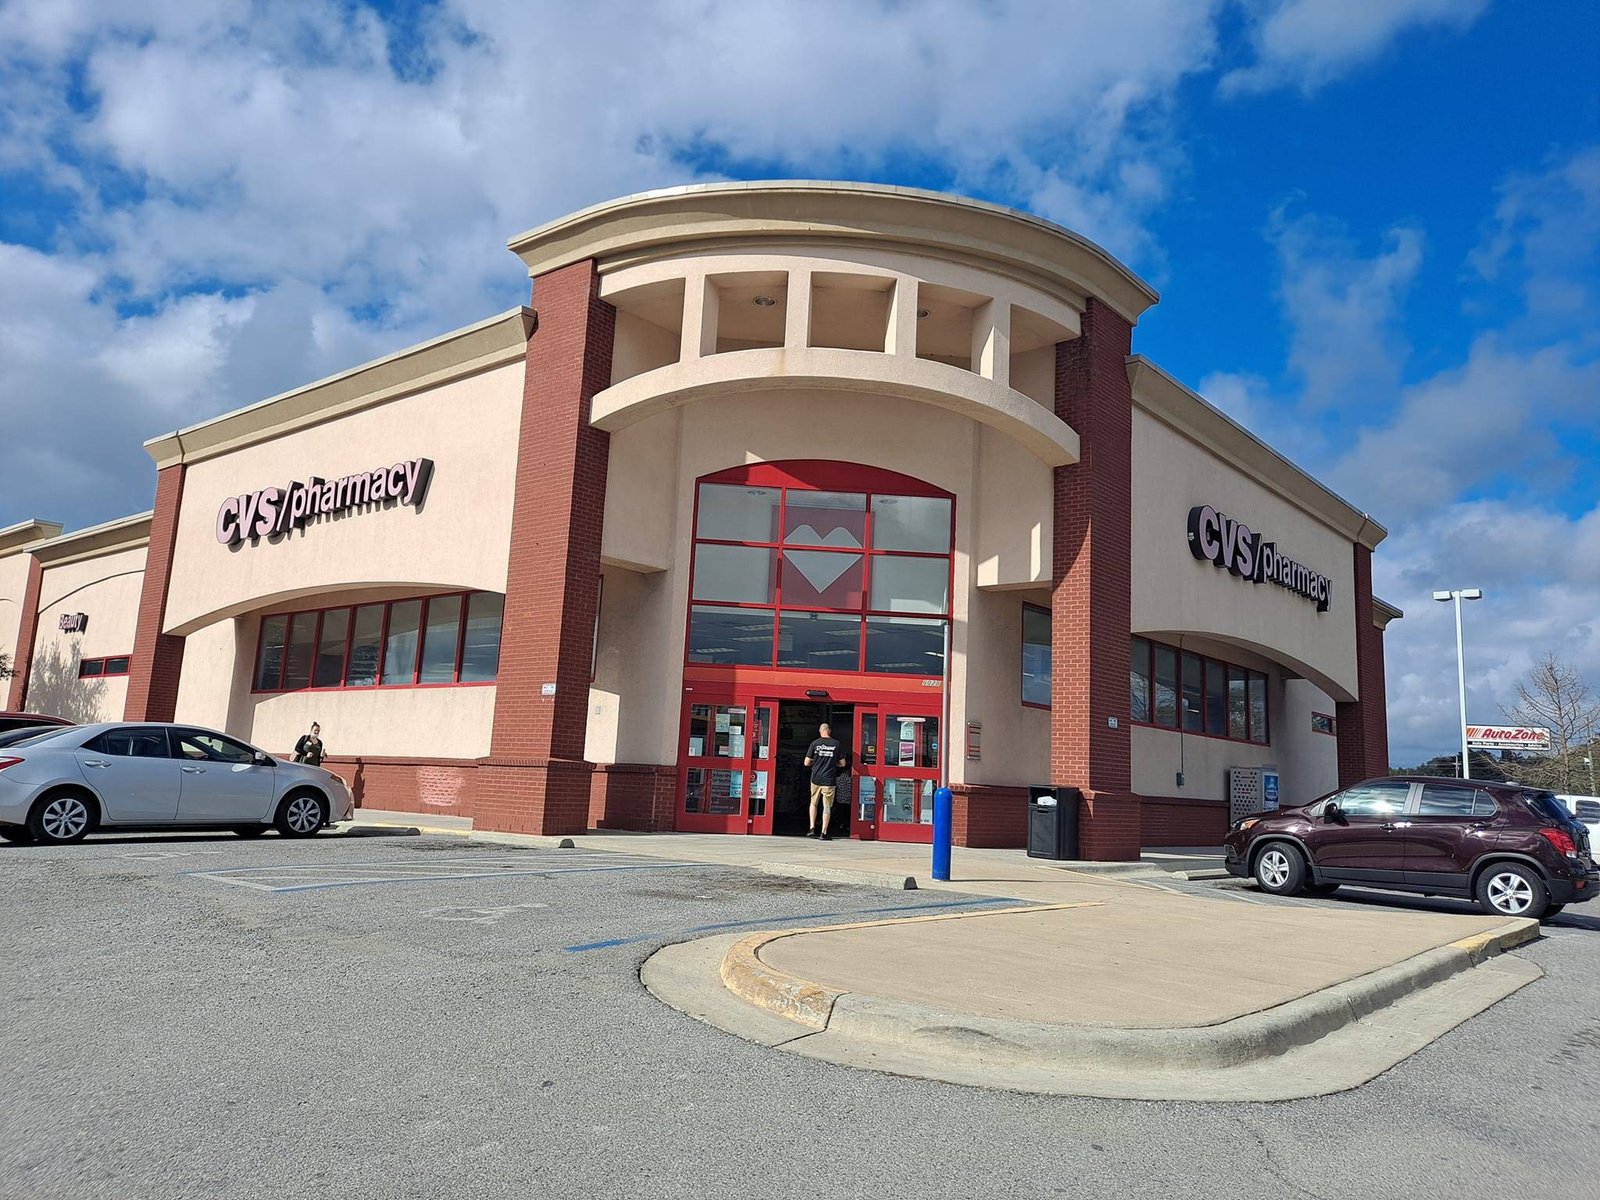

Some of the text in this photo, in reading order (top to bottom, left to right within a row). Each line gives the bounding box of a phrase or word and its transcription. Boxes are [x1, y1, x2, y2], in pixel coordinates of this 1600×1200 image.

[216, 458, 434, 544] CVS/pharmacy
[1188, 504, 1333, 612] CVS/pharmacy
[1481, 728, 1545, 740] AutoZone
